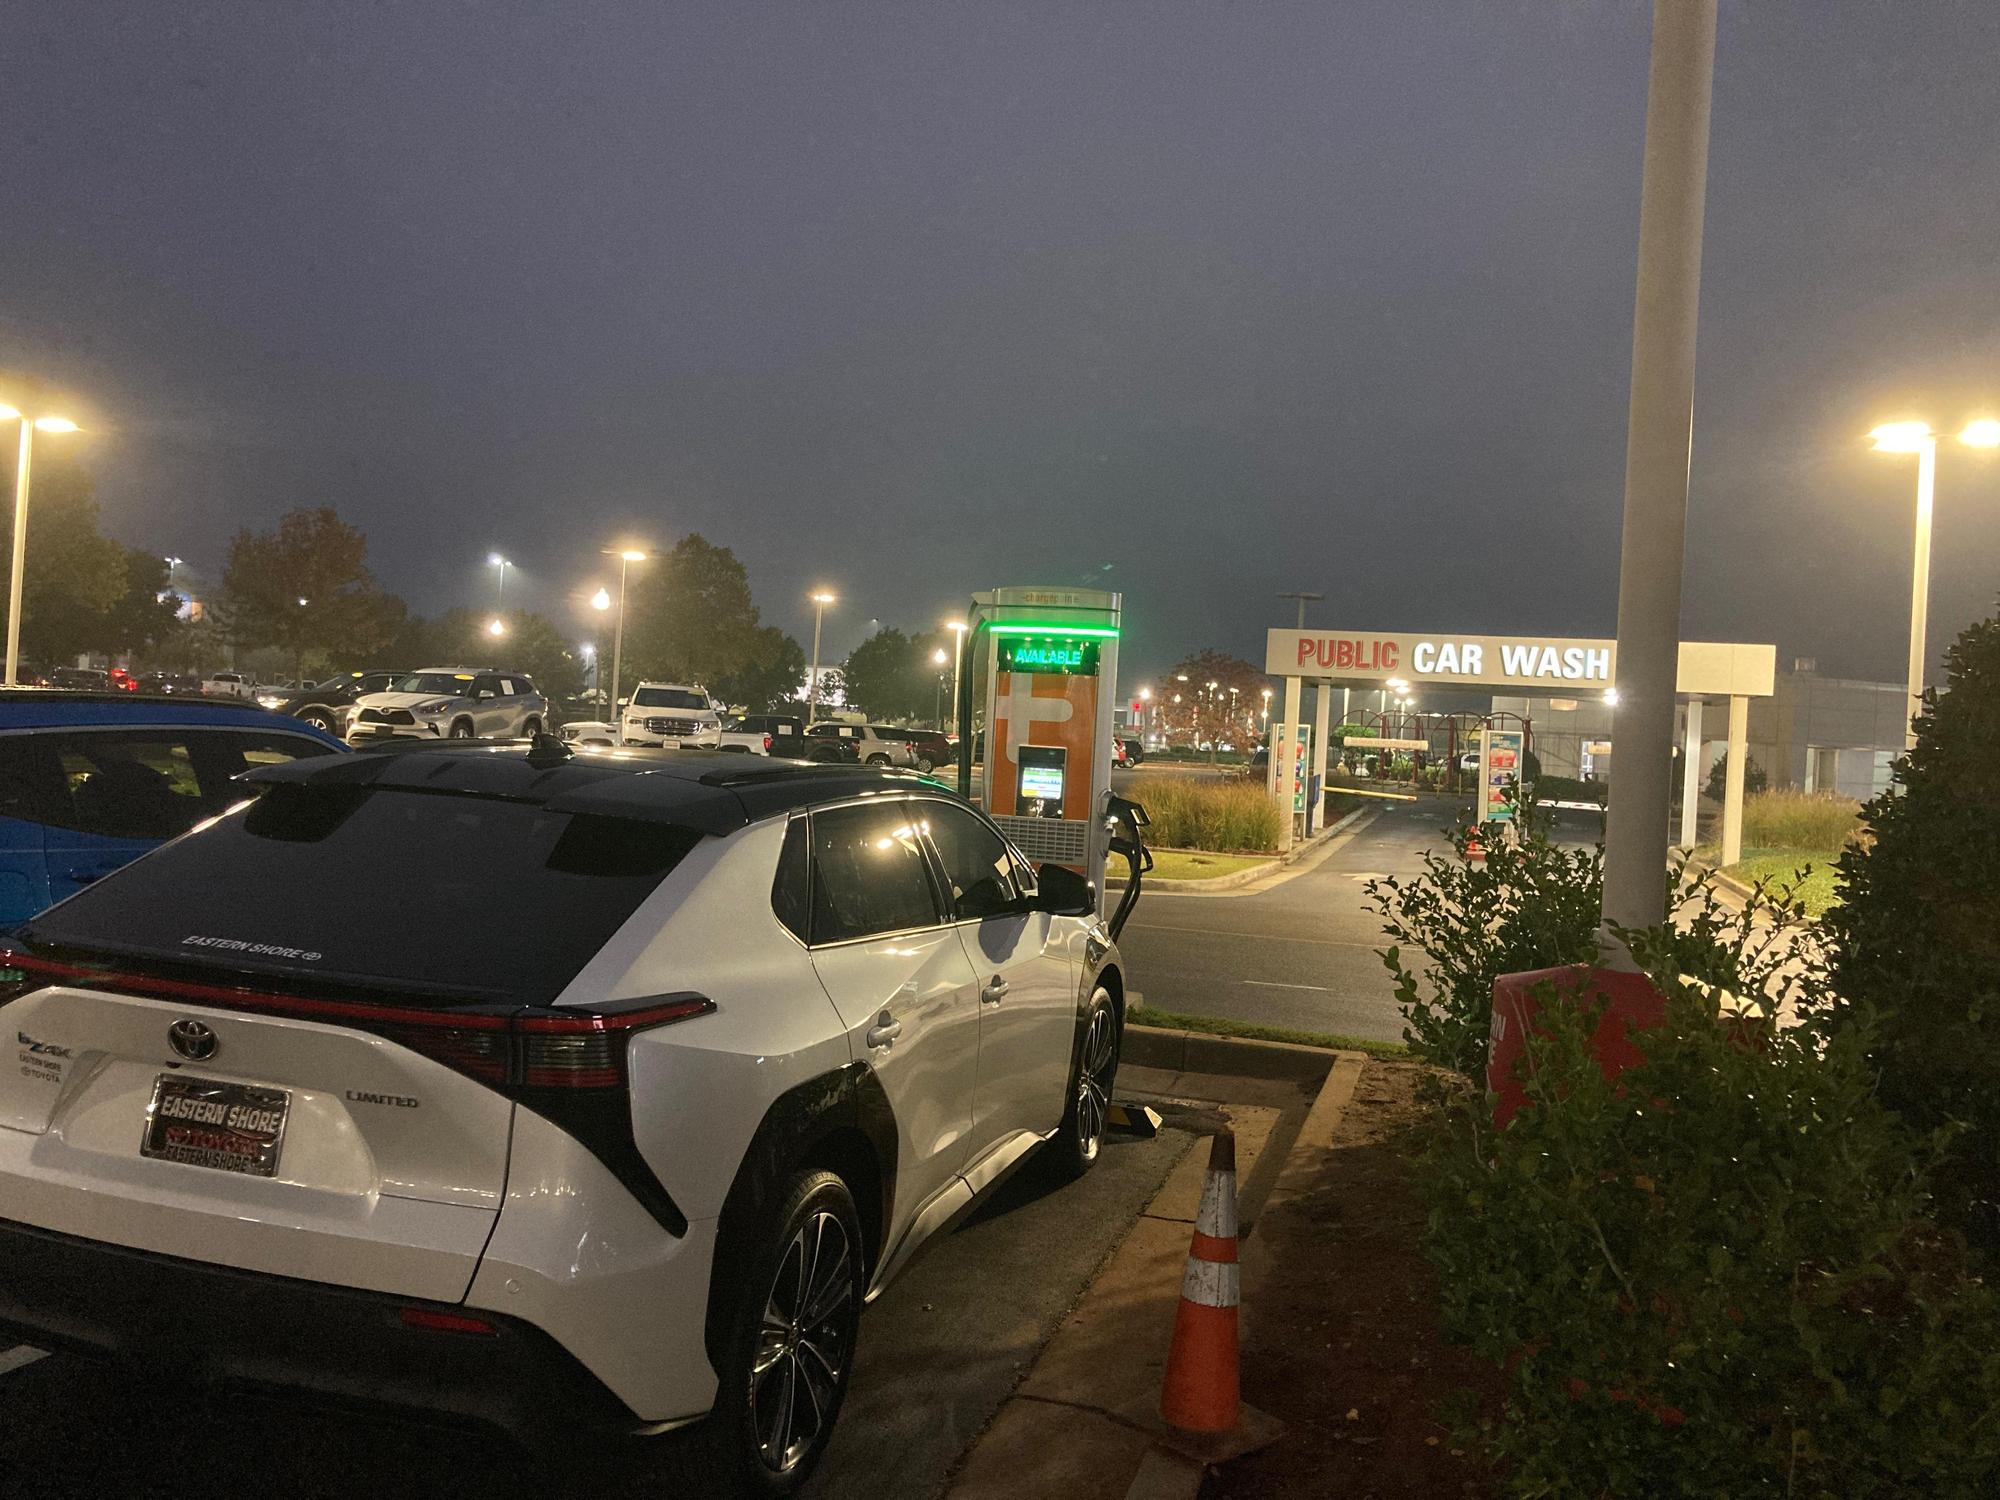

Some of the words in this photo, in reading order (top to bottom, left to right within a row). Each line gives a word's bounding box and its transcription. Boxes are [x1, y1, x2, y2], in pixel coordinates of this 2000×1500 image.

[1015, 649, 1081, 665] AVAILABLE
[1297, 638, 1399, 670] PUBLIC
[1413, 642, 1483, 675] CAR
[1502, 644, 1609, 680] WASH
[181, 935, 251, 951] EASTERN
[249, 943, 304, 959] SHORE
[346, 1090, 418, 1108] LIMITED
[161, 1097, 229, 1125] EASTERN
[227, 1105, 281, 1134] SHORE
[166, 1145, 212, 1166] EASTERN
[214, 1152, 251, 1172] SHORE
